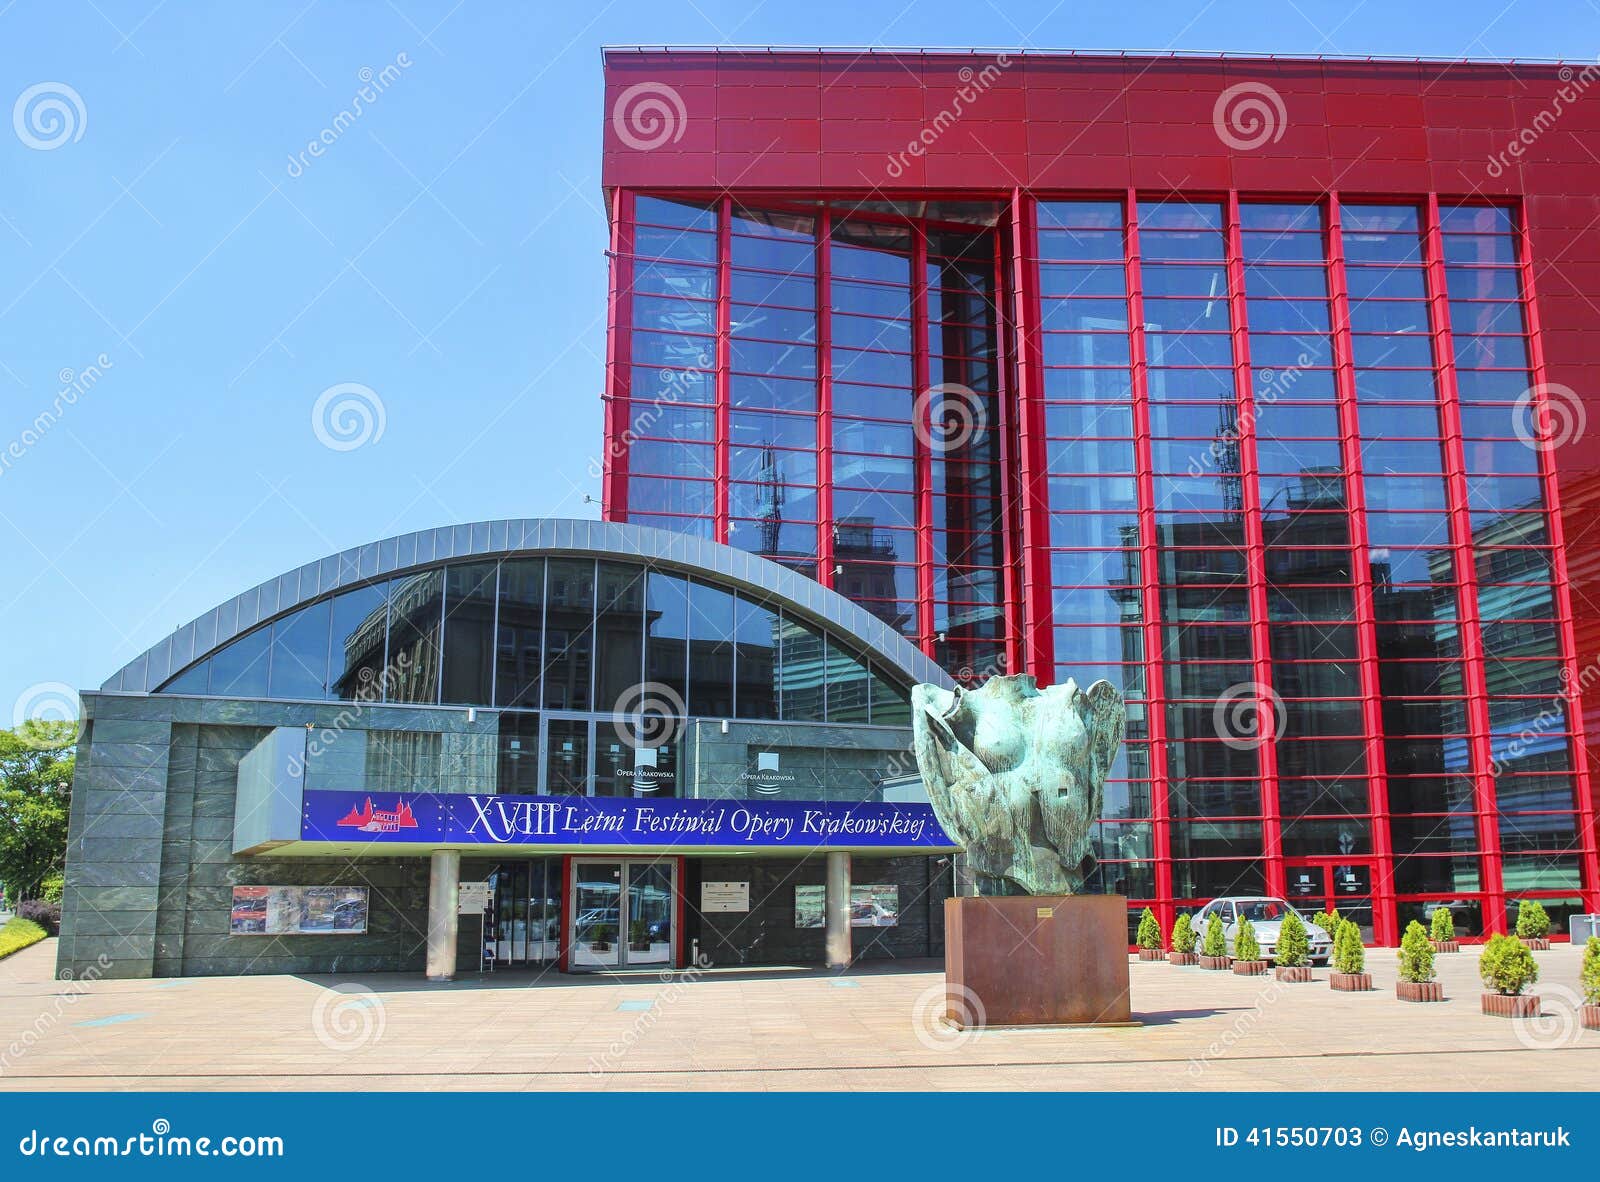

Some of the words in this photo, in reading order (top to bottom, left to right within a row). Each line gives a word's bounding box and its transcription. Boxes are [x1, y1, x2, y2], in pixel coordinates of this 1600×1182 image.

[466, 796, 562, 843] XVIII
[561, 805, 627, 832] Letni
[632, 808, 724, 834] Festiwal
[730, 809, 794, 841] Opery
[801, 810, 925, 841] Krakowskiej
